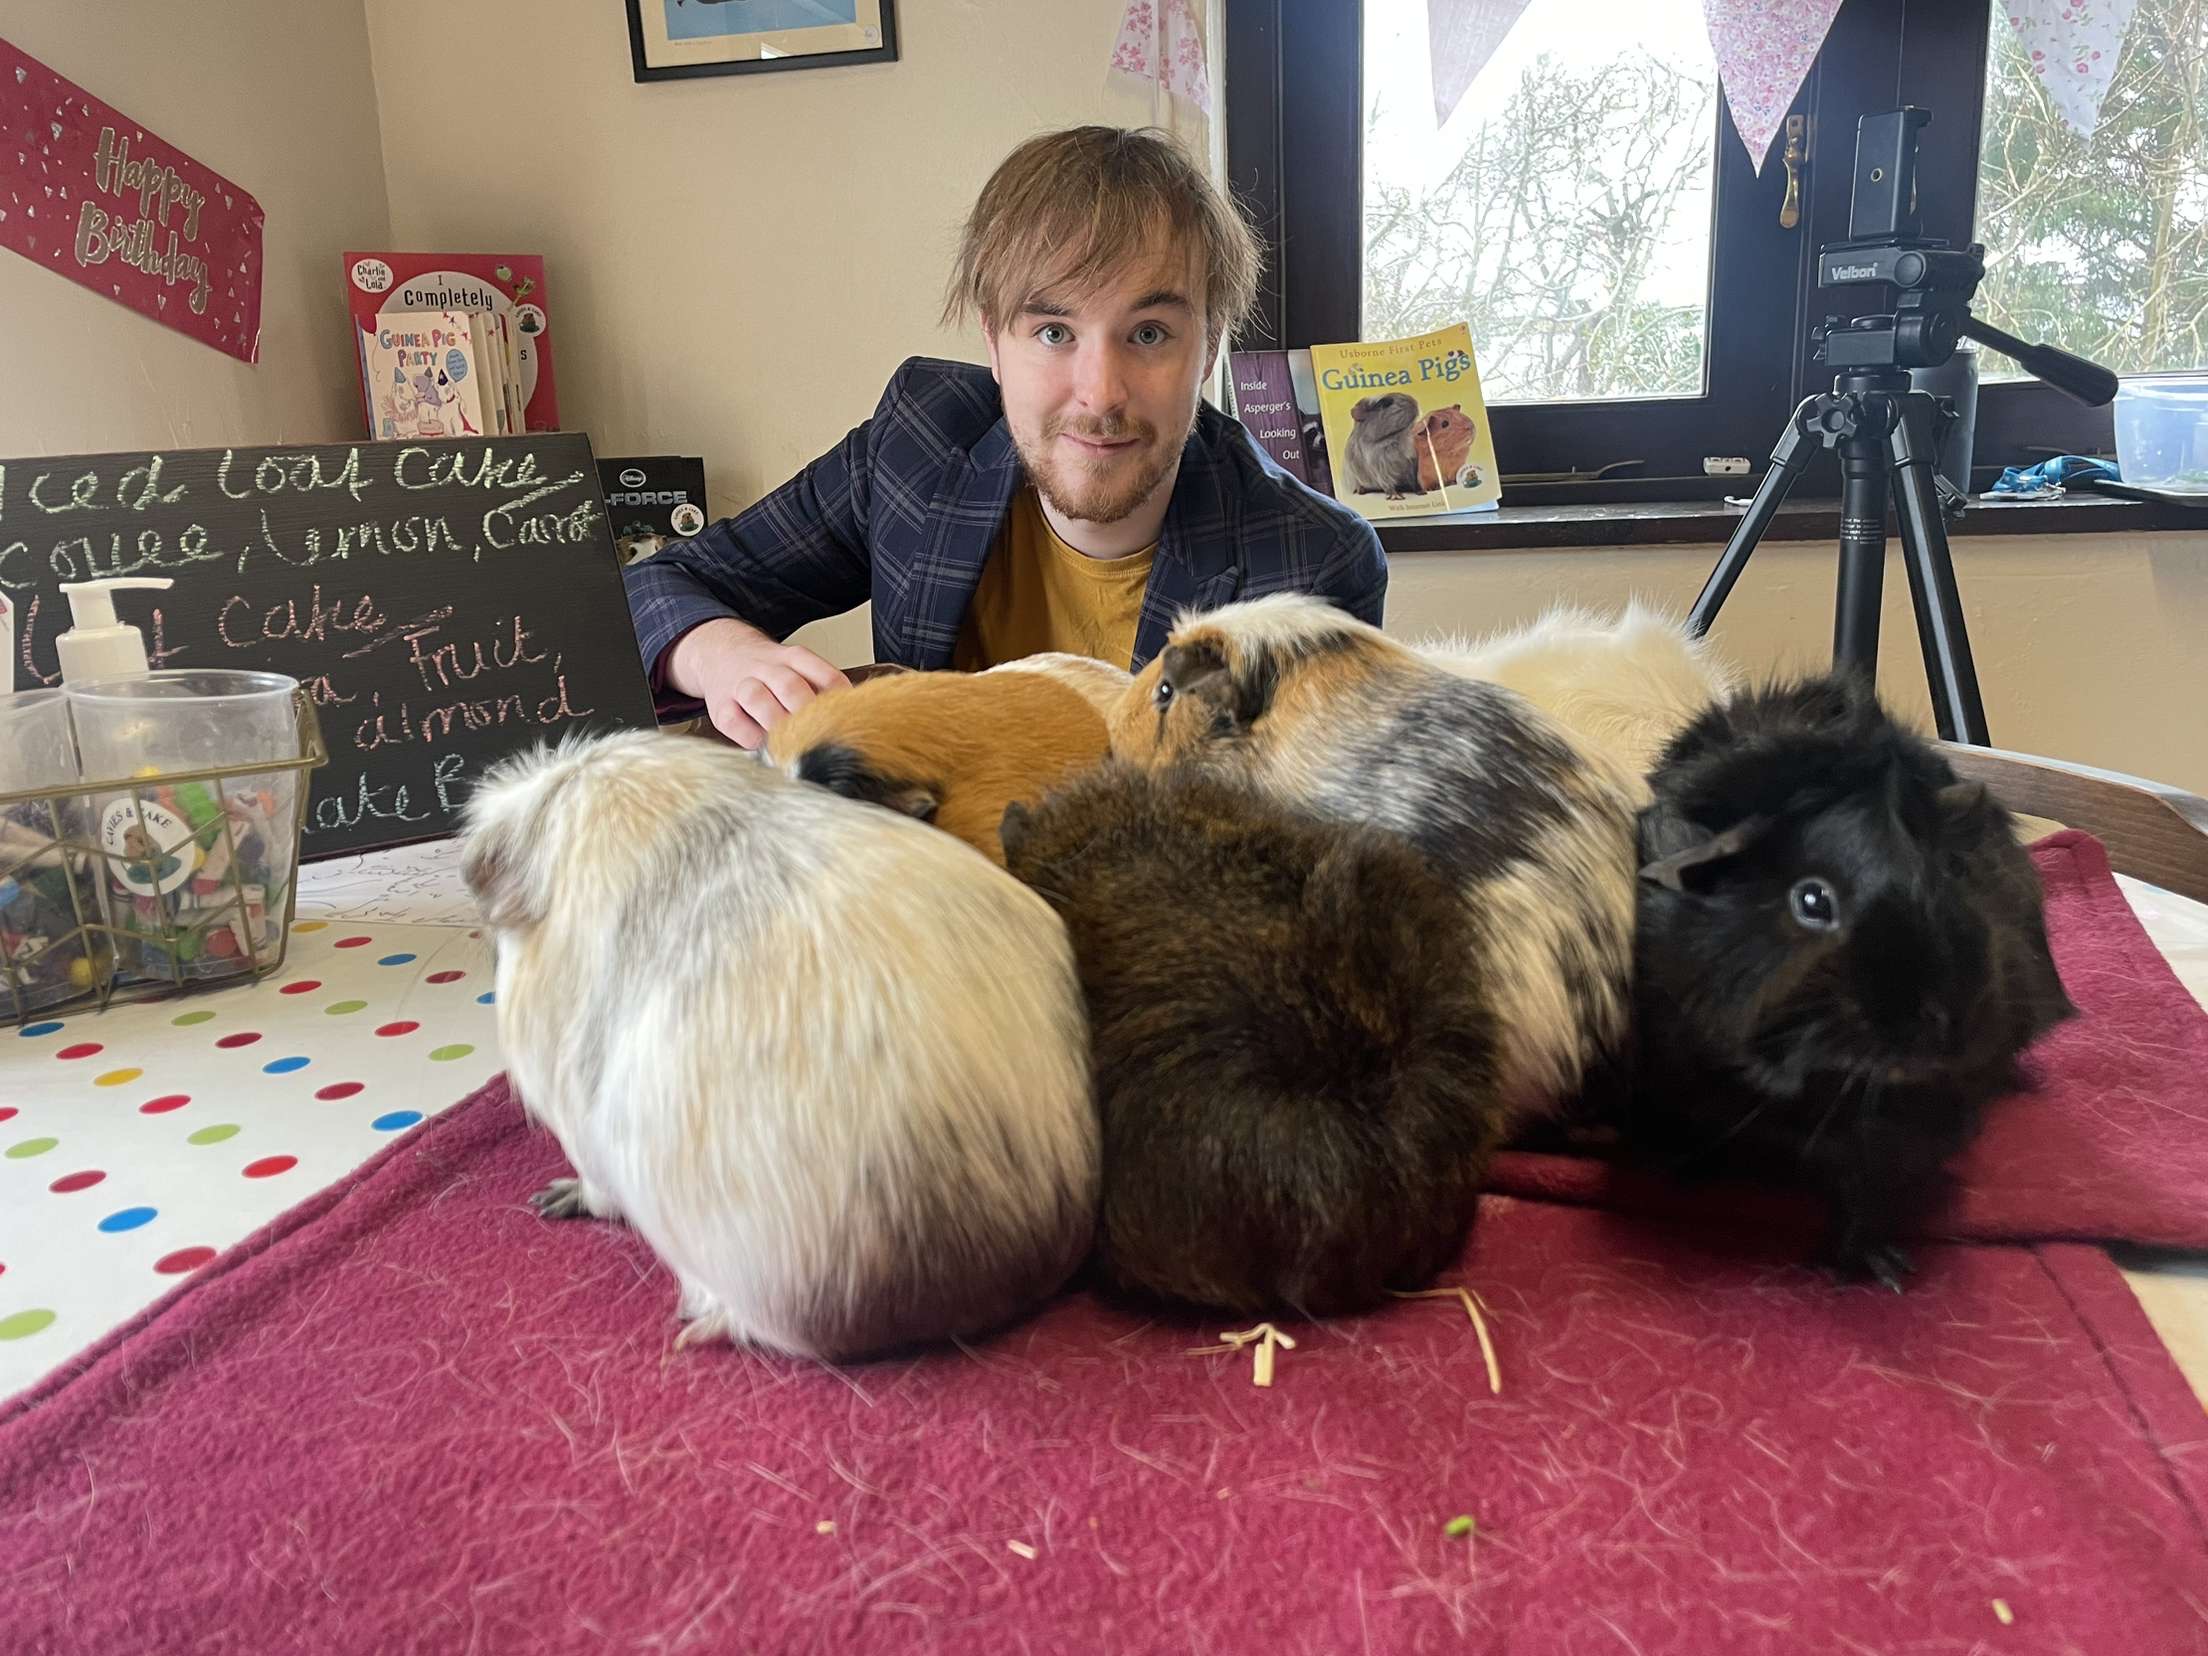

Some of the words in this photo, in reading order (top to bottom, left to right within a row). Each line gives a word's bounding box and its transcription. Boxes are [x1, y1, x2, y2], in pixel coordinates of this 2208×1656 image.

[93, 127, 206, 242] Happy
[75, 200, 212, 315] Birthday
[357, 264, 386, 276] Charlie
[1831, 265, 1876, 281] Velbon
[365, 278, 384, 290] Lola
[380, 329, 430, 349] GUINEA
[431, 328, 456, 349] PIG
[1339, 348, 1385, 359] Usborne
[1388, 343, 1414, 355] First
[1418, 338, 1443, 350] Pets
[397, 349, 438, 368] PARTY
[1322, 366, 1412, 391] Guinea
[1418, 350, 1472, 383] Pigs
[1240, 380, 1268, 391] Inside
[1243, 400, 1292, 415] Asperger's
[1260, 428, 1297, 440] Looking
[1282, 449, 1300, 460] Out
[217, 583, 385, 648] Cake
[301, 771, 431, 836] ake
